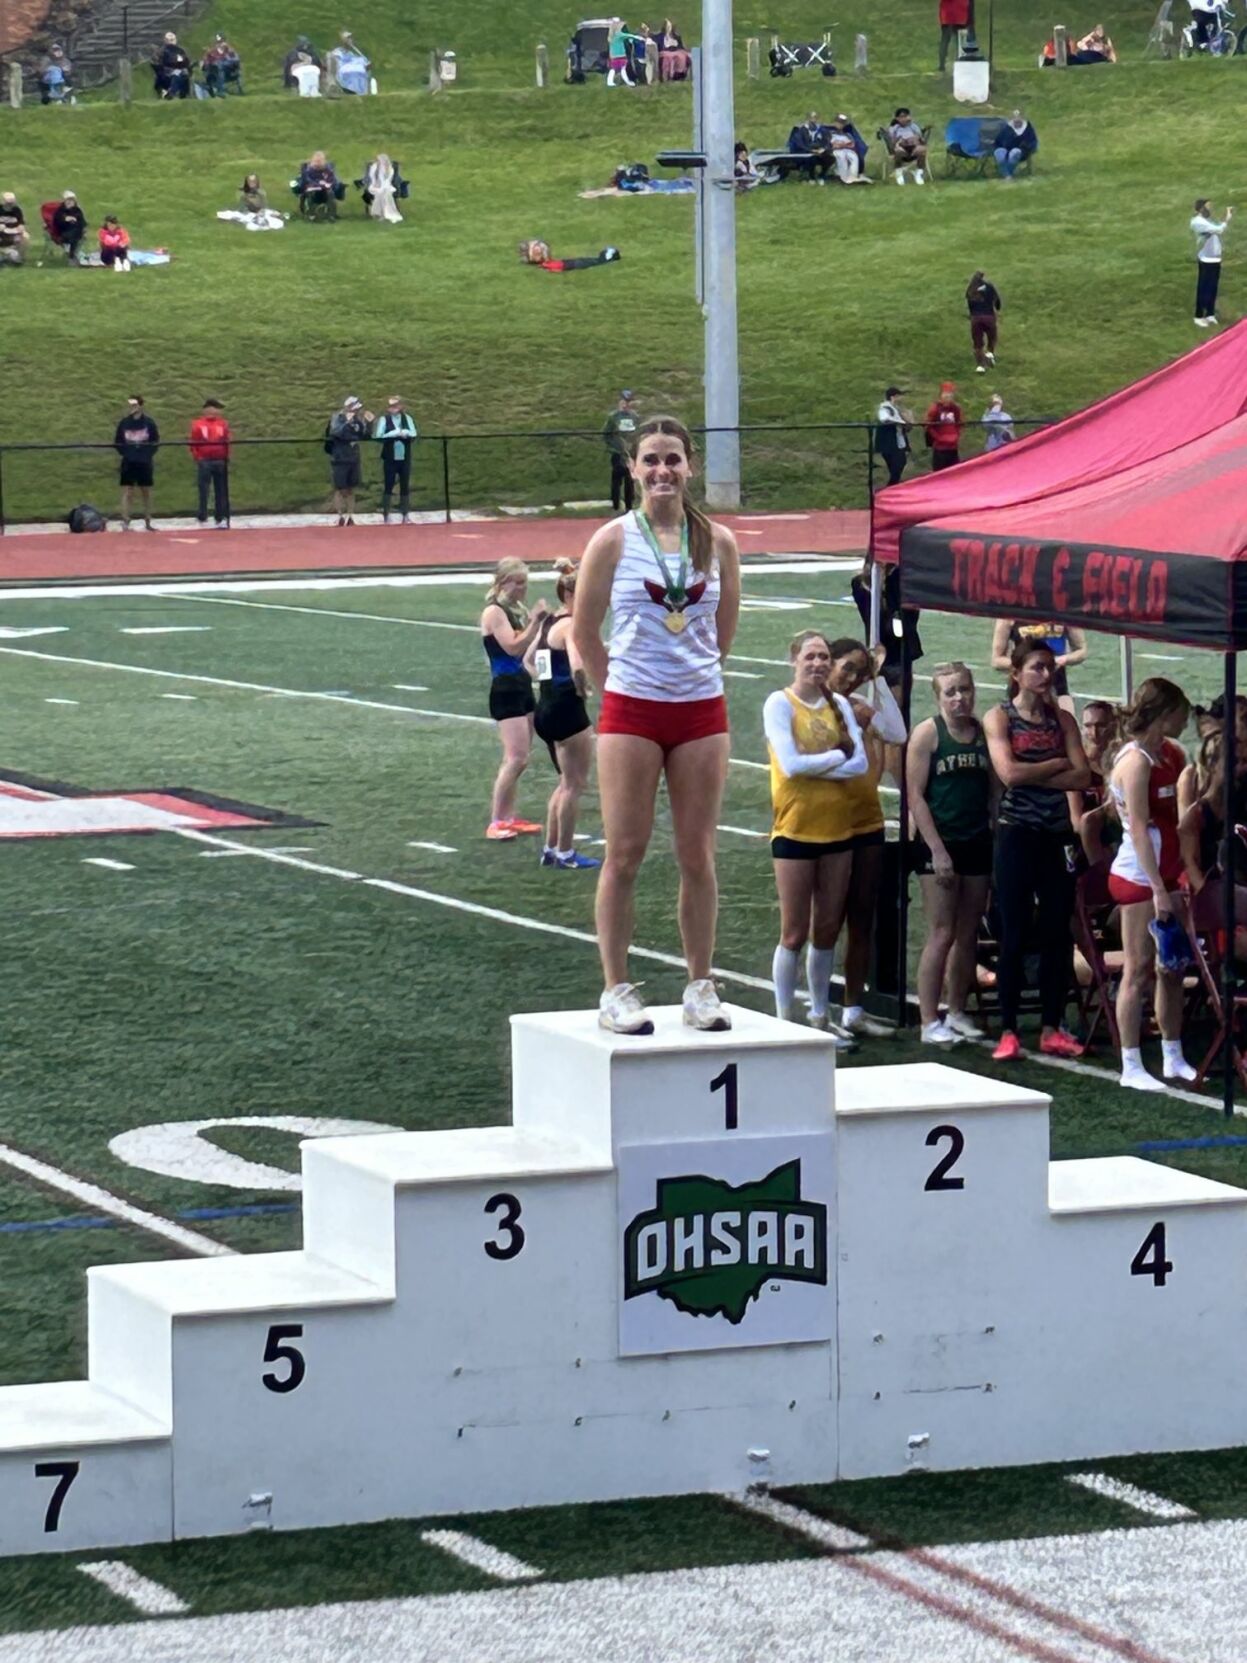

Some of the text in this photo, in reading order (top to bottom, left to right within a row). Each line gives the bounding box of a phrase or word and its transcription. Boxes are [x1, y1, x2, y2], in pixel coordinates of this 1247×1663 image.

[949, 538, 1041, 607] TRACK
[1082, 552, 1168, 624] FIELD
[709, 1062, 739, 1131] 1
[924, 1124, 966, 1192] 2
[483, 1192, 525, 1261] 3
[636, 1210, 815, 1283] OHSAA
[1129, 1221, 1174, 1288] 4
[262, 1323, 306, 1394] 5
[34, 1460, 80, 1533] 7
